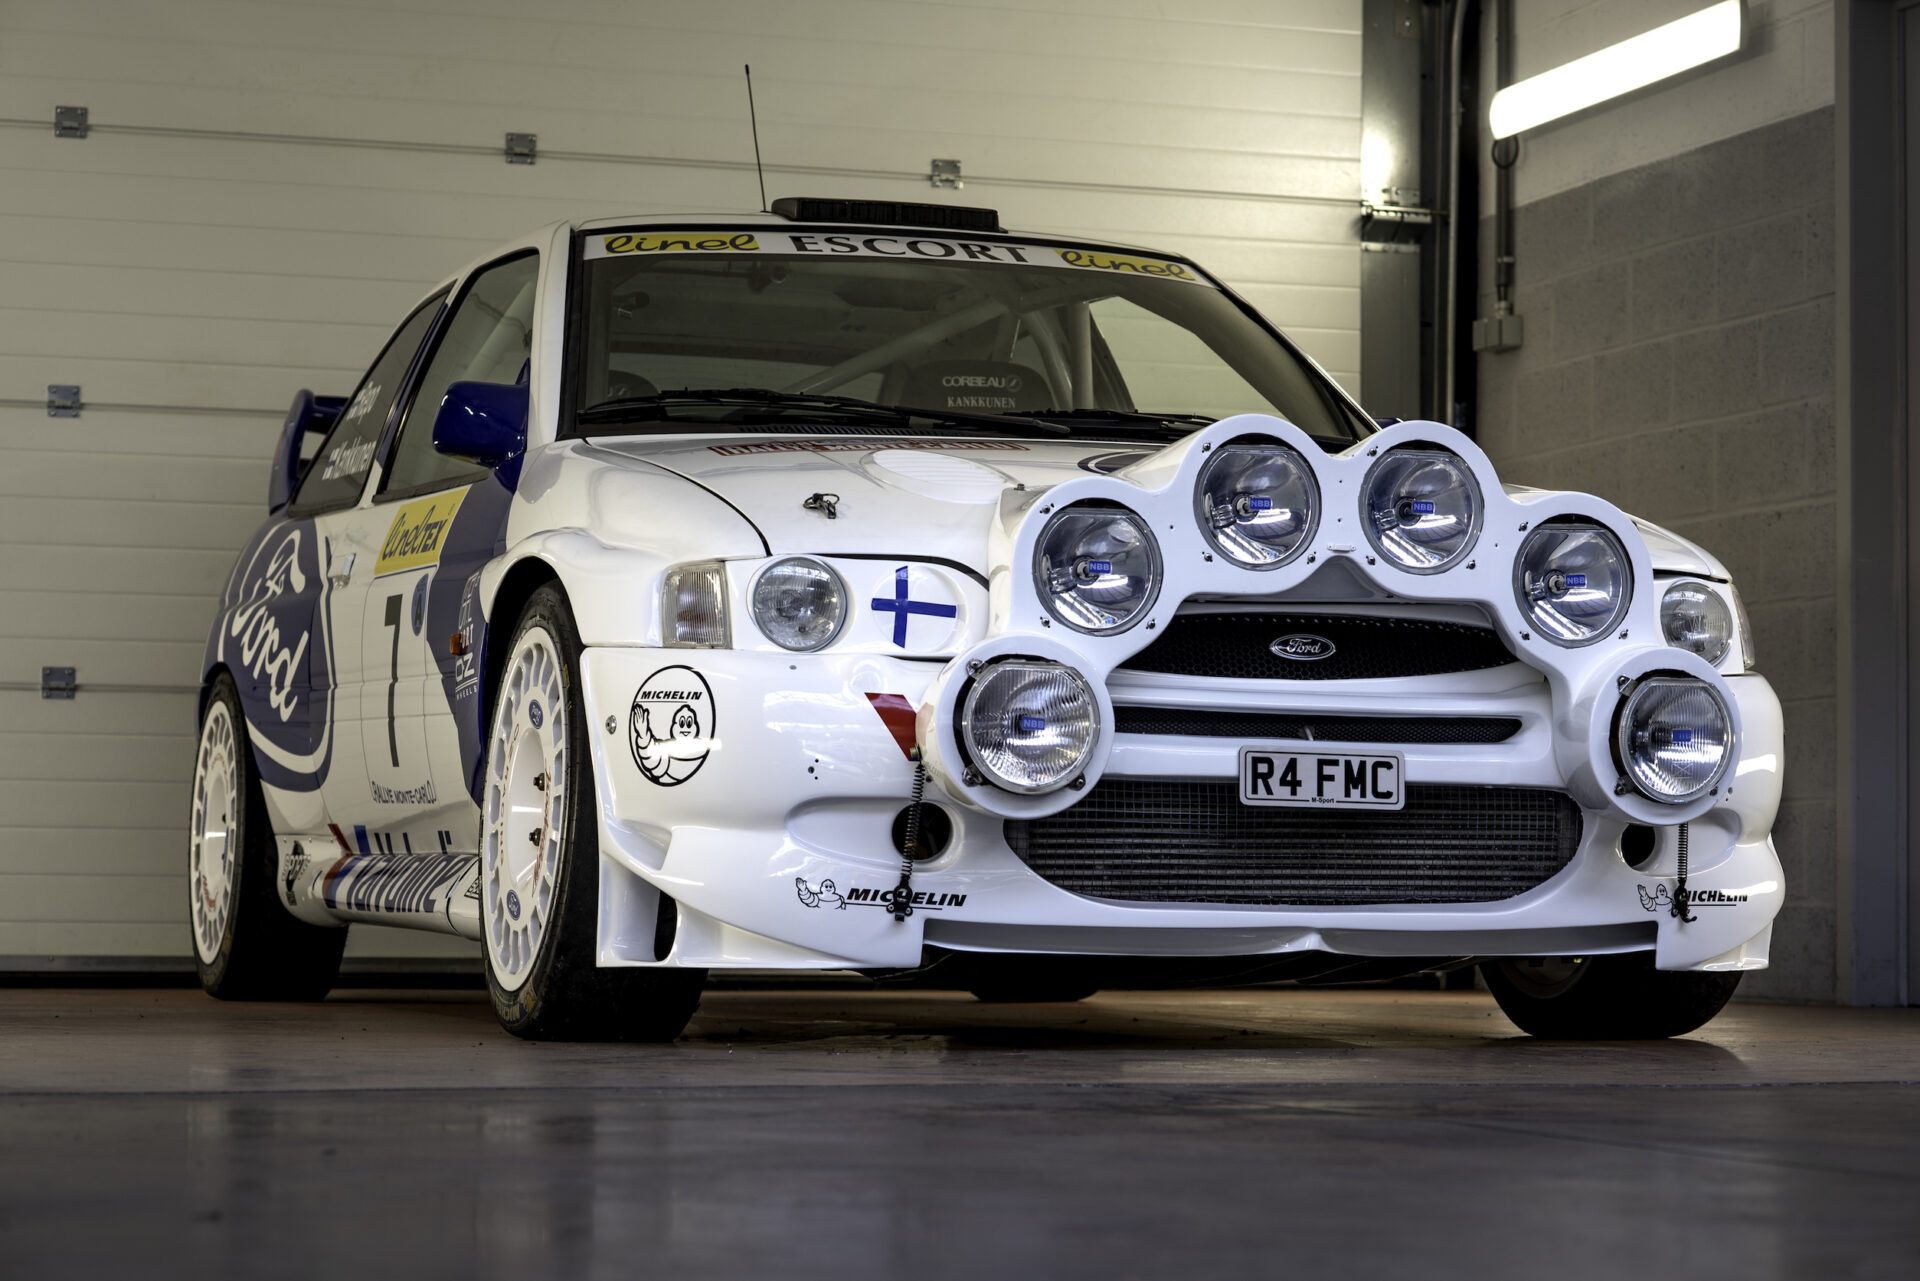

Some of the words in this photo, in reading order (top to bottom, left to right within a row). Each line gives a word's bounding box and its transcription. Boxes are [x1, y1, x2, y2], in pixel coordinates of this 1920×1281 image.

[605, 233, 760, 254] linel
[788, 234, 1029, 263] ESCORT
[1060, 250, 1196, 282] linel
[942, 376, 1006, 389] CORBEAU
[947, 396, 1017, 409] KANKKUNEN
[231, 529, 309, 723] Ford
[1286, 638, 1321, 653] Ford
[456, 652, 475, 683] OZ
[640, 690, 703, 701] MICHELIN
[1251, 756, 1302, 797] R4
[1317, 759, 1394, 799] FMC
[1311, 796, 1335, 804] M-Sport
[847, 888, 967, 907] MICELIN
